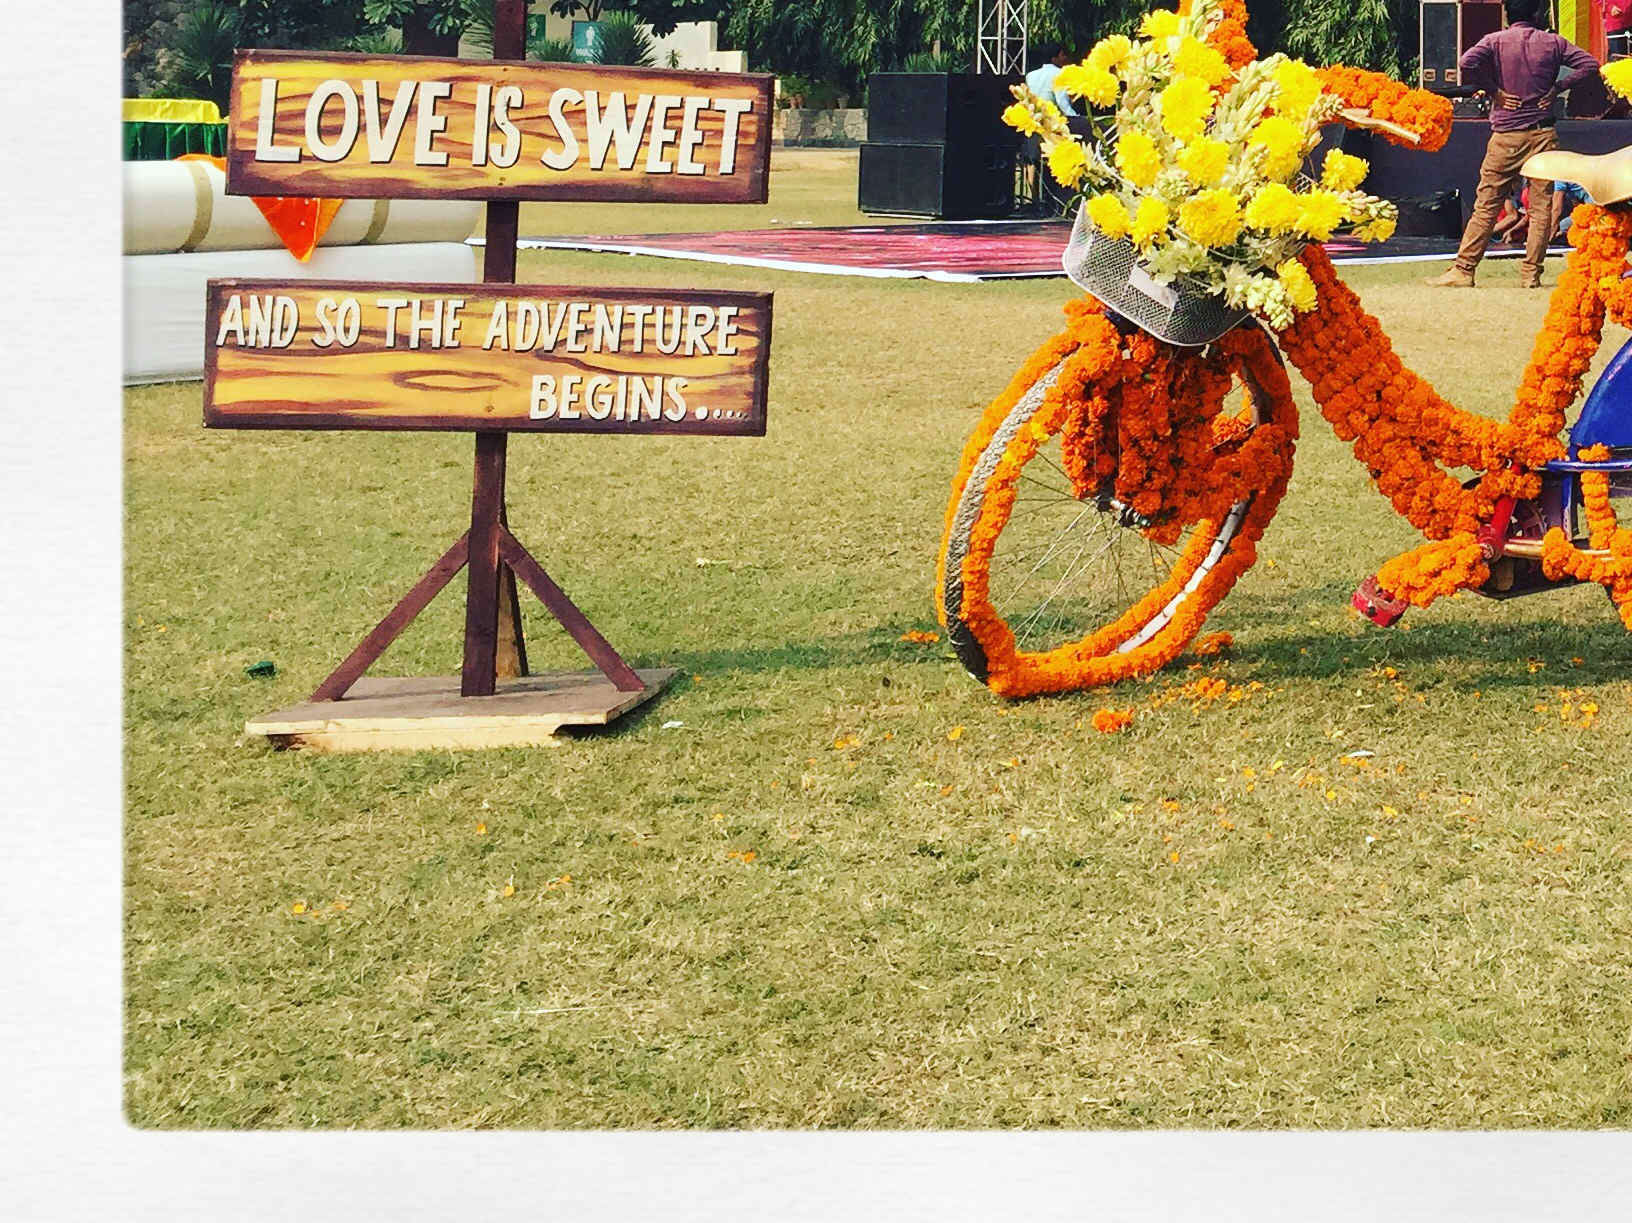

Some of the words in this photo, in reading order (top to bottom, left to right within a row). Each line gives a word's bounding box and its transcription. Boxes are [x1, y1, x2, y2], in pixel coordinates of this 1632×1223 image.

[254, 78, 451, 165] LOVE
[472, 84, 523, 168] IS
[541, 87, 753, 175] SWEET
[215, 295, 298, 349] AND
[311, 297, 361, 347] SO
[376, 297, 465, 349] THE
[482, 301, 738, 356] ADVENTURE
